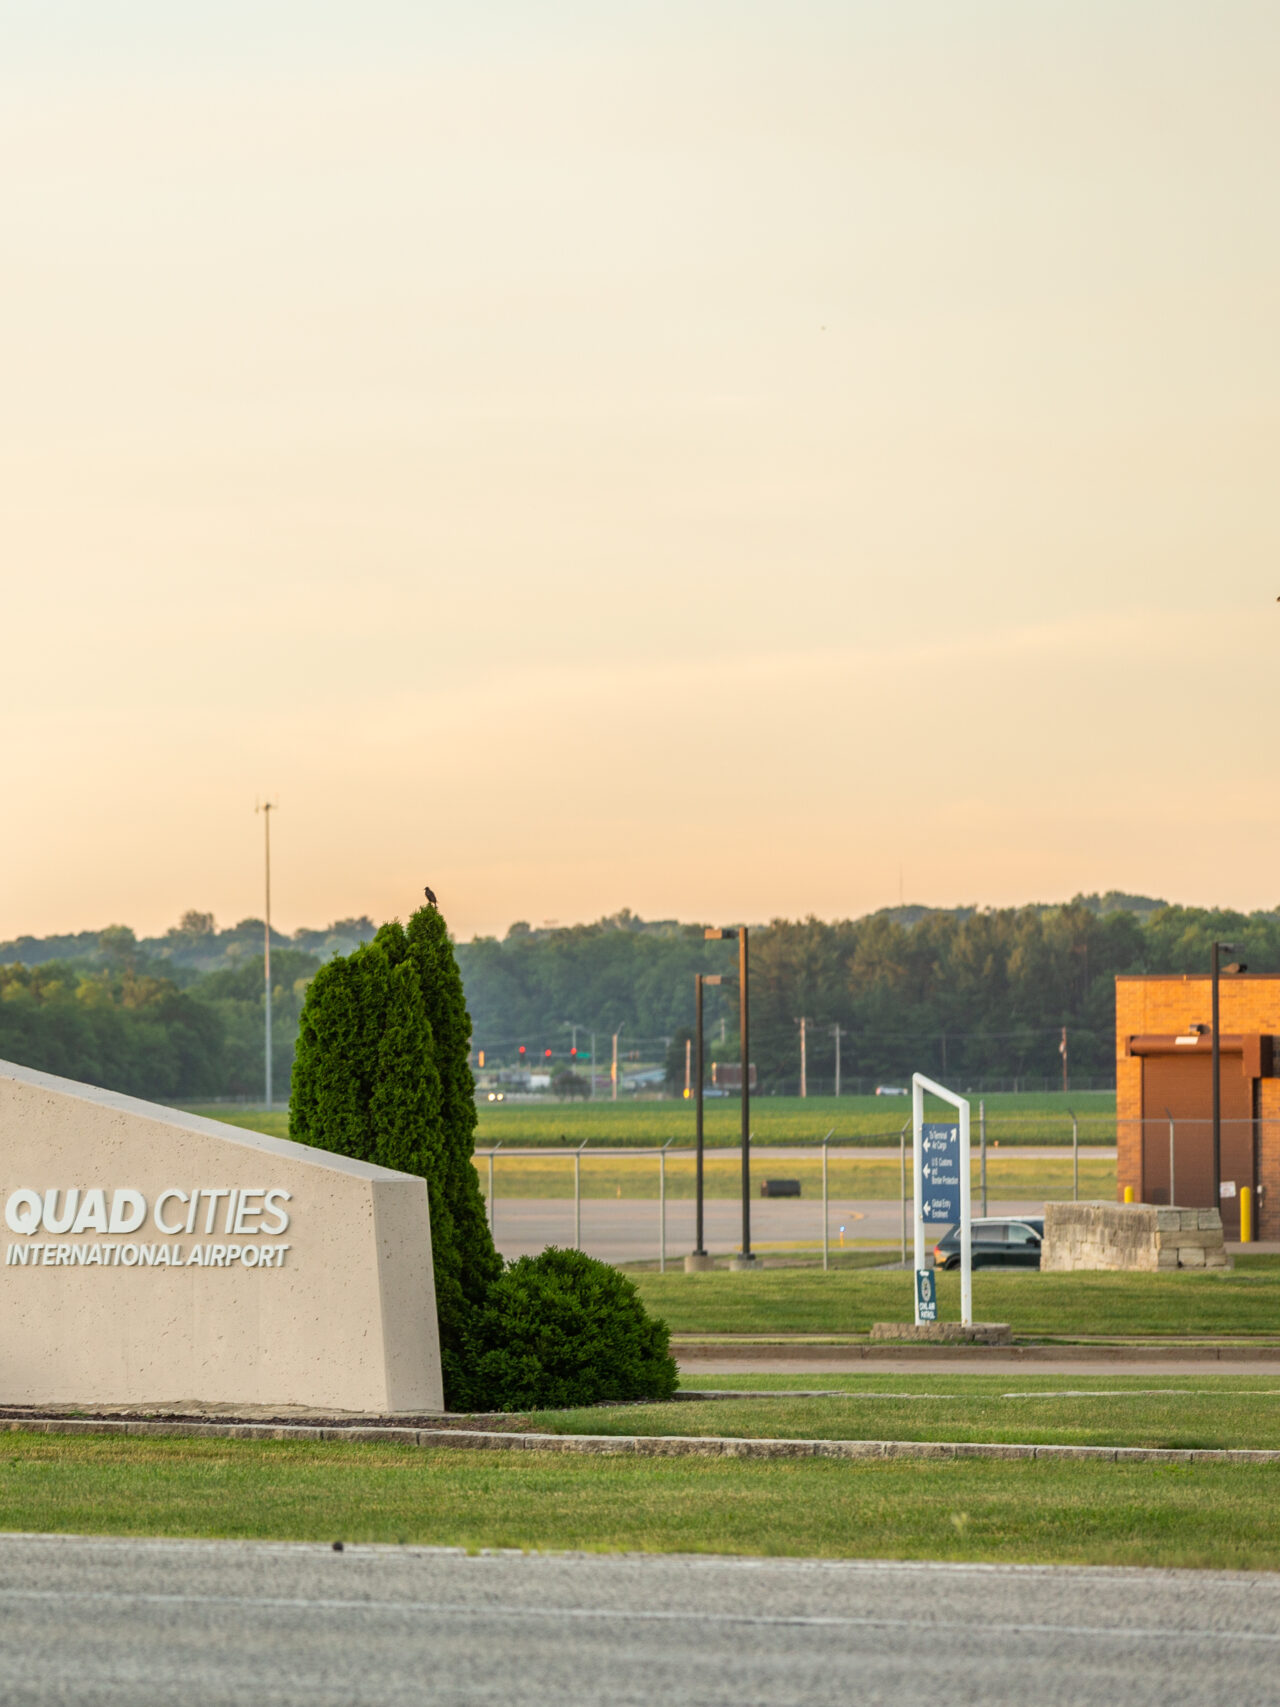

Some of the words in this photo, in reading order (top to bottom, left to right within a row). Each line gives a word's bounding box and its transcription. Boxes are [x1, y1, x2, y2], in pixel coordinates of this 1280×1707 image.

[5, 1188, 146, 1236] QUAD
[154, 1188, 292, 1235] CITIES
[6, 1243, 185, 1267] INTERNATIONAL
[185, 1244, 290, 1267] AIRPORT
